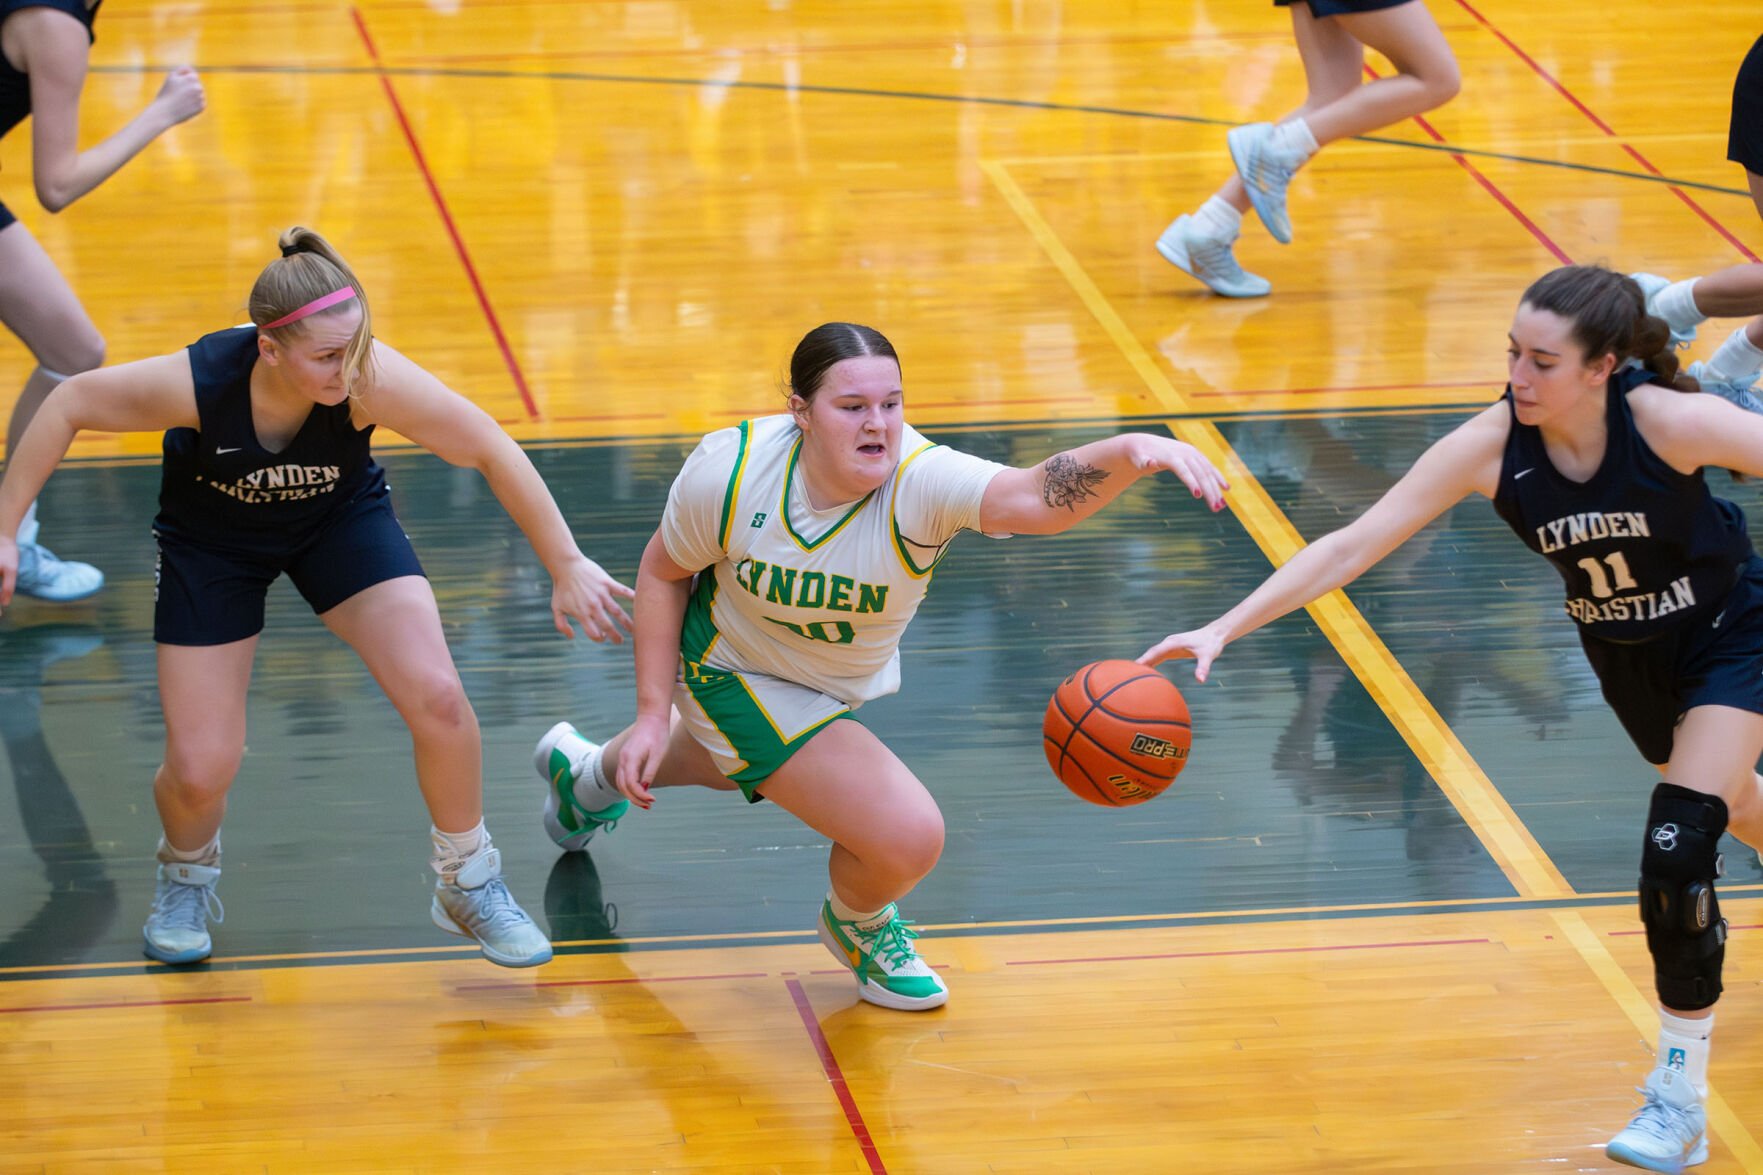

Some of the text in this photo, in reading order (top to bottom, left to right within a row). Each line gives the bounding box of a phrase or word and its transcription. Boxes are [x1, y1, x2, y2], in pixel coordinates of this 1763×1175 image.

[1536, 512, 1651, 553] LYNDEN
[1577, 551, 1638, 598] 11
[1564, 576, 1696, 624] HRISTIAN
